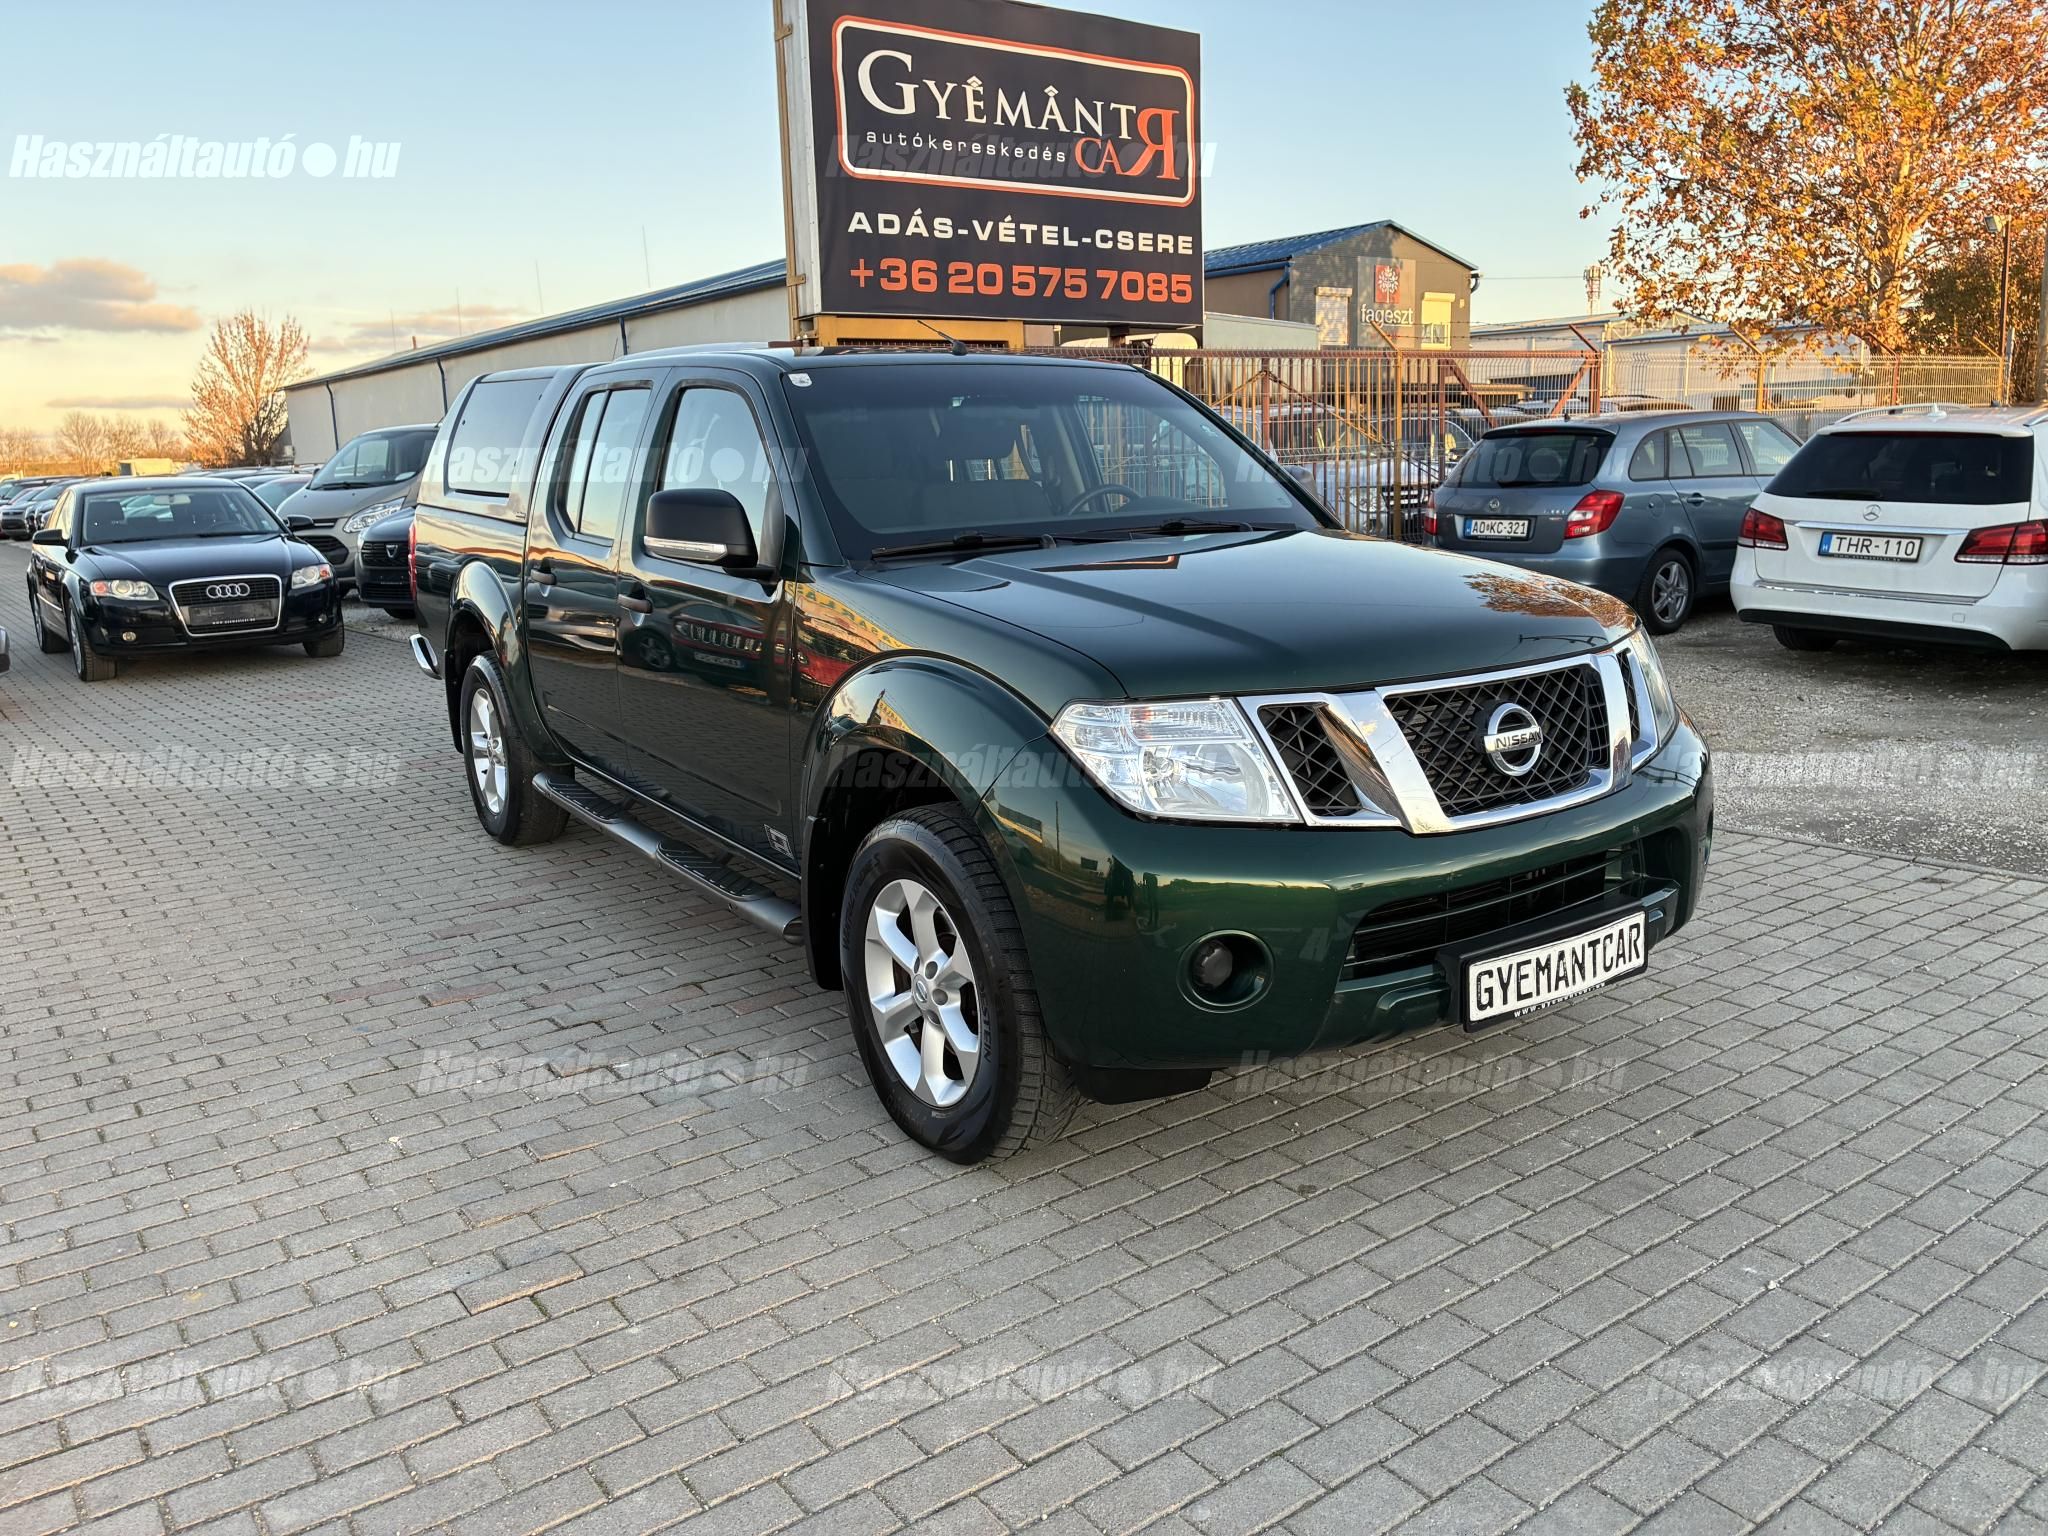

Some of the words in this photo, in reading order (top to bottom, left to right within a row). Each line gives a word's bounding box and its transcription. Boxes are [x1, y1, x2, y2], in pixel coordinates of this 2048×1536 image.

[866, 130, 1066, 163] autókereskedés
[847, 207, 1193, 254] ADÁS-VÉTEL-CSERE
[850, 257, 938, 293] +36
[948, 261, 1003, 295] 20
[1011, 264, 1088, 299] 575
[1096, 269, 1193, 304] 7085
[1360, 303, 1414, 328] fageszt
[1836, 536, 1915, 556] THR-110
[1496, 730, 1541, 748] NISSAN
[1476, 922, 1641, 1012] GYEMANTCAR
